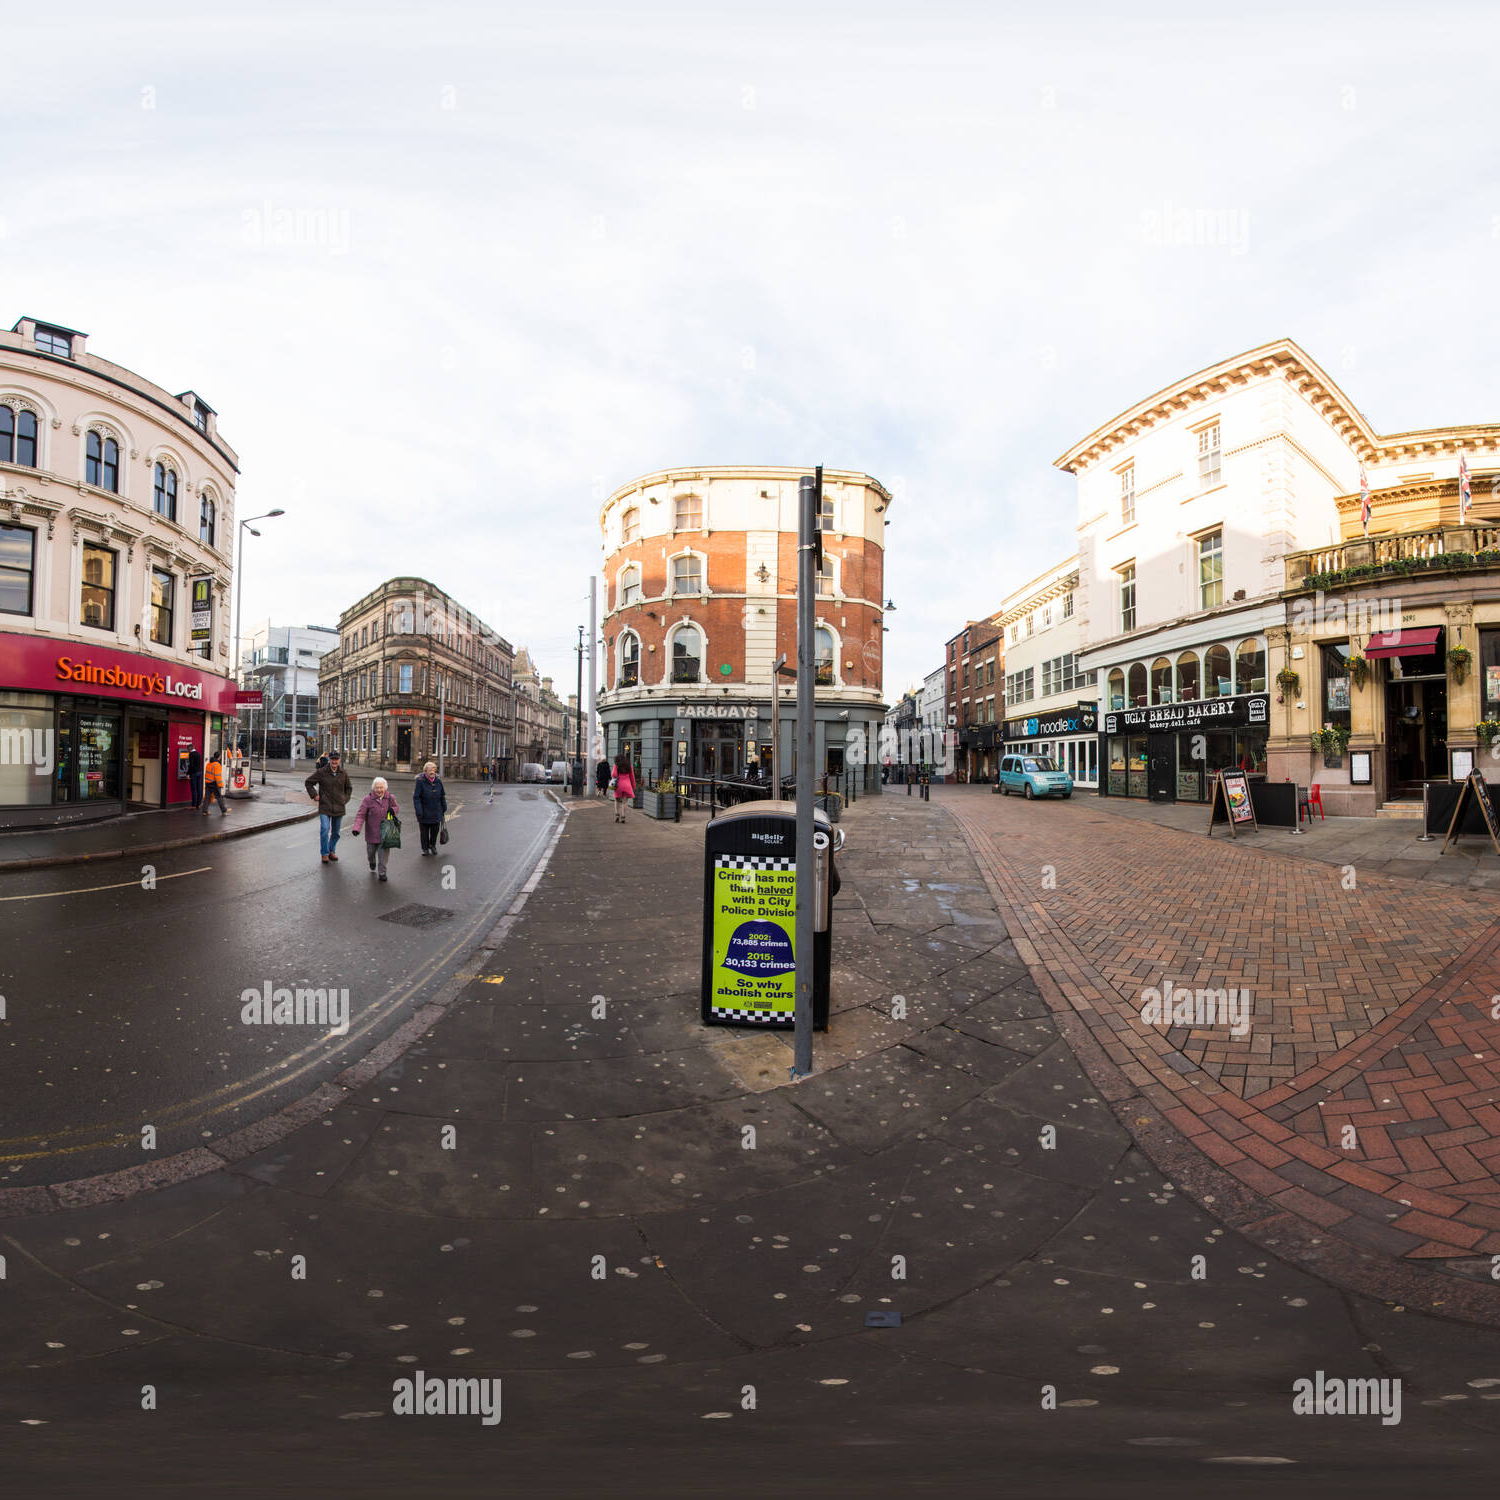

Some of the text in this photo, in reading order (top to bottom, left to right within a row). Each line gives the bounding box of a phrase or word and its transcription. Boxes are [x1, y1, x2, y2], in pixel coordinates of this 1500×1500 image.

[56, 656, 203, 700] Sainsbury's Local
[676, 705, 759, 718] FARADAYS
[1124, 711, 1147, 725] UGLY
[1148, 707, 1184, 722] BREAD
[1187, 701, 1236, 718] BAKERY
[751, 833, 784, 841] BigBelly
[718, 871, 751, 881] Crime
[755, 873, 774, 883] has
[730, 883, 793, 895] than halved
[732, 896, 755, 905] with
[768, 897, 791, 907] City
[721, 905, 755, 915] Police
[748, 933, 772, 941] 2002:
[747, 952, 774, 960] 2015:
[725, 958, 796, 969] 30,133 crimes
[736, 979, 783, 991] So why
[717, 987, 796, 999] abolish ours
